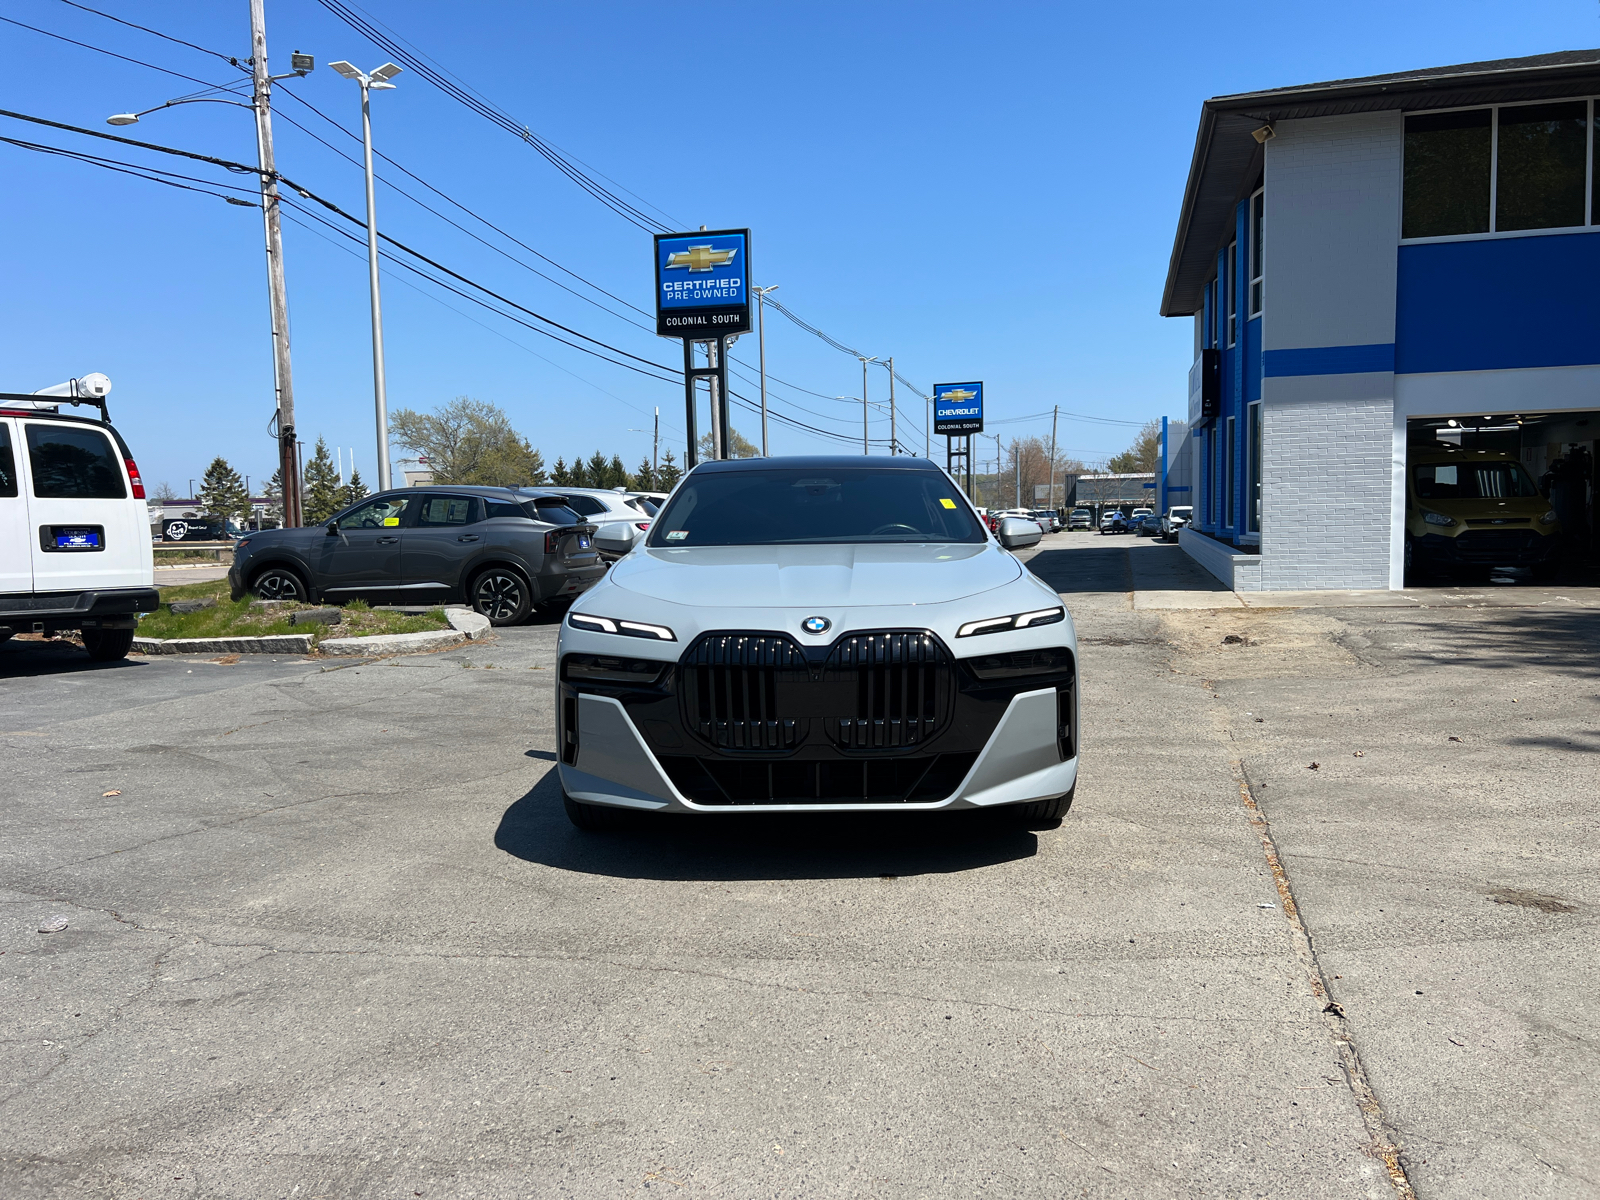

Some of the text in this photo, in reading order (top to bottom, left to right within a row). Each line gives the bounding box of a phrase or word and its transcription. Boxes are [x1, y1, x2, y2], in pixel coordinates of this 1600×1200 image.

[663, 278, 741, 292] CERTIFIED
[667, 288, 737, 300] PRE-OWNED
[666, 314, 740, 326] COLONIAL SOUTH
[938, 408, 979, 416] CHEVROLET
